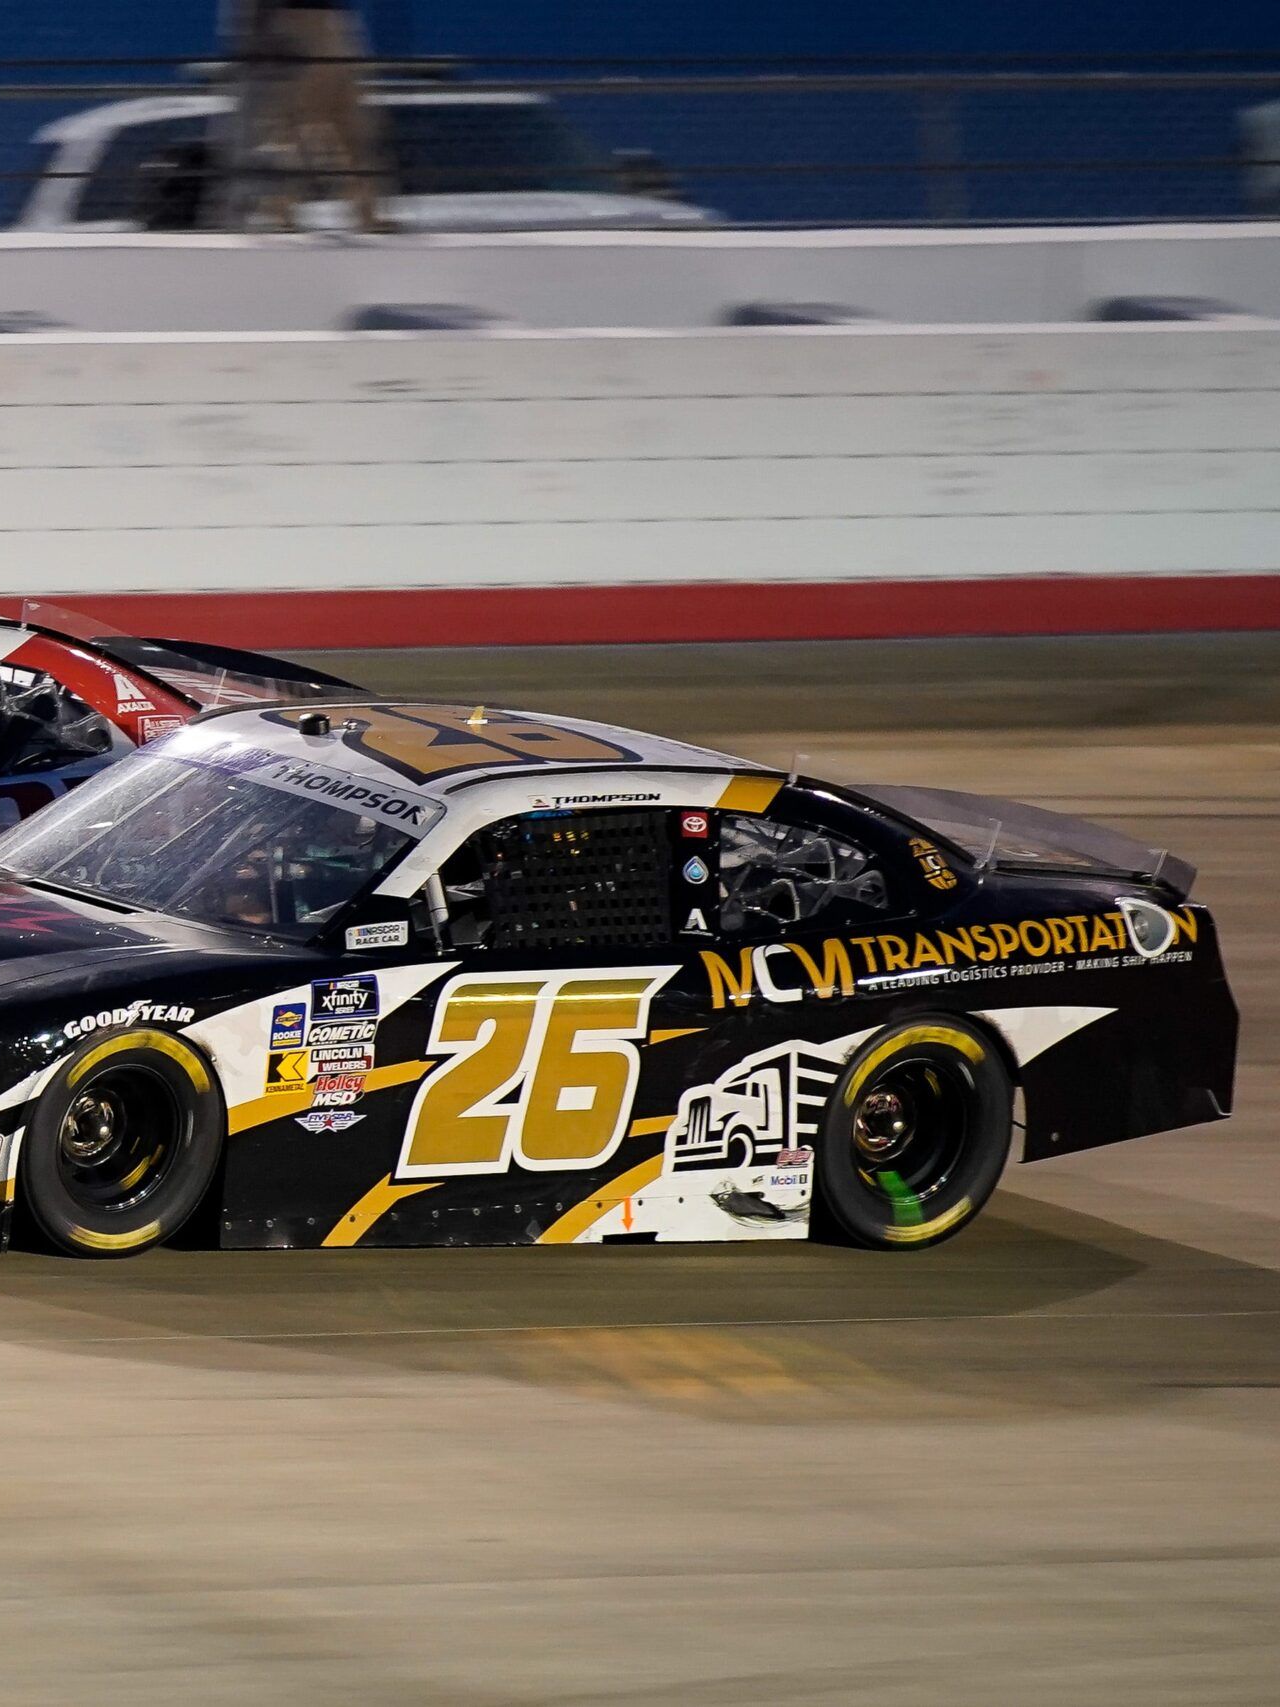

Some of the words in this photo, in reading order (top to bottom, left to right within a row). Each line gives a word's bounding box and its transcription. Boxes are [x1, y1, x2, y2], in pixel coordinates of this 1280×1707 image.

[272, 765, 424, 826] THOMPSON
[552, 793, 662, 808] THOMPSON
[356, 936, 380, 946] RACE
[382, 934, 400, 943] CAR
[851, 906, 1198, 974] TRANSPORTATN
[943, 965, 1008, 983] LOGISTICS
[322, 990, 368, 1011] xfinity
[272, 1030, 302, 1041] ROOKIE
[308, 1022, 376, 1044] COMETIC
[312, 1047, 363, 1061] LINCOLN
[322, 1060, 367, 1072] WELDERS
[394, 965, 683, 1179] 26
[313, 1091, 357, 1107] MSD
